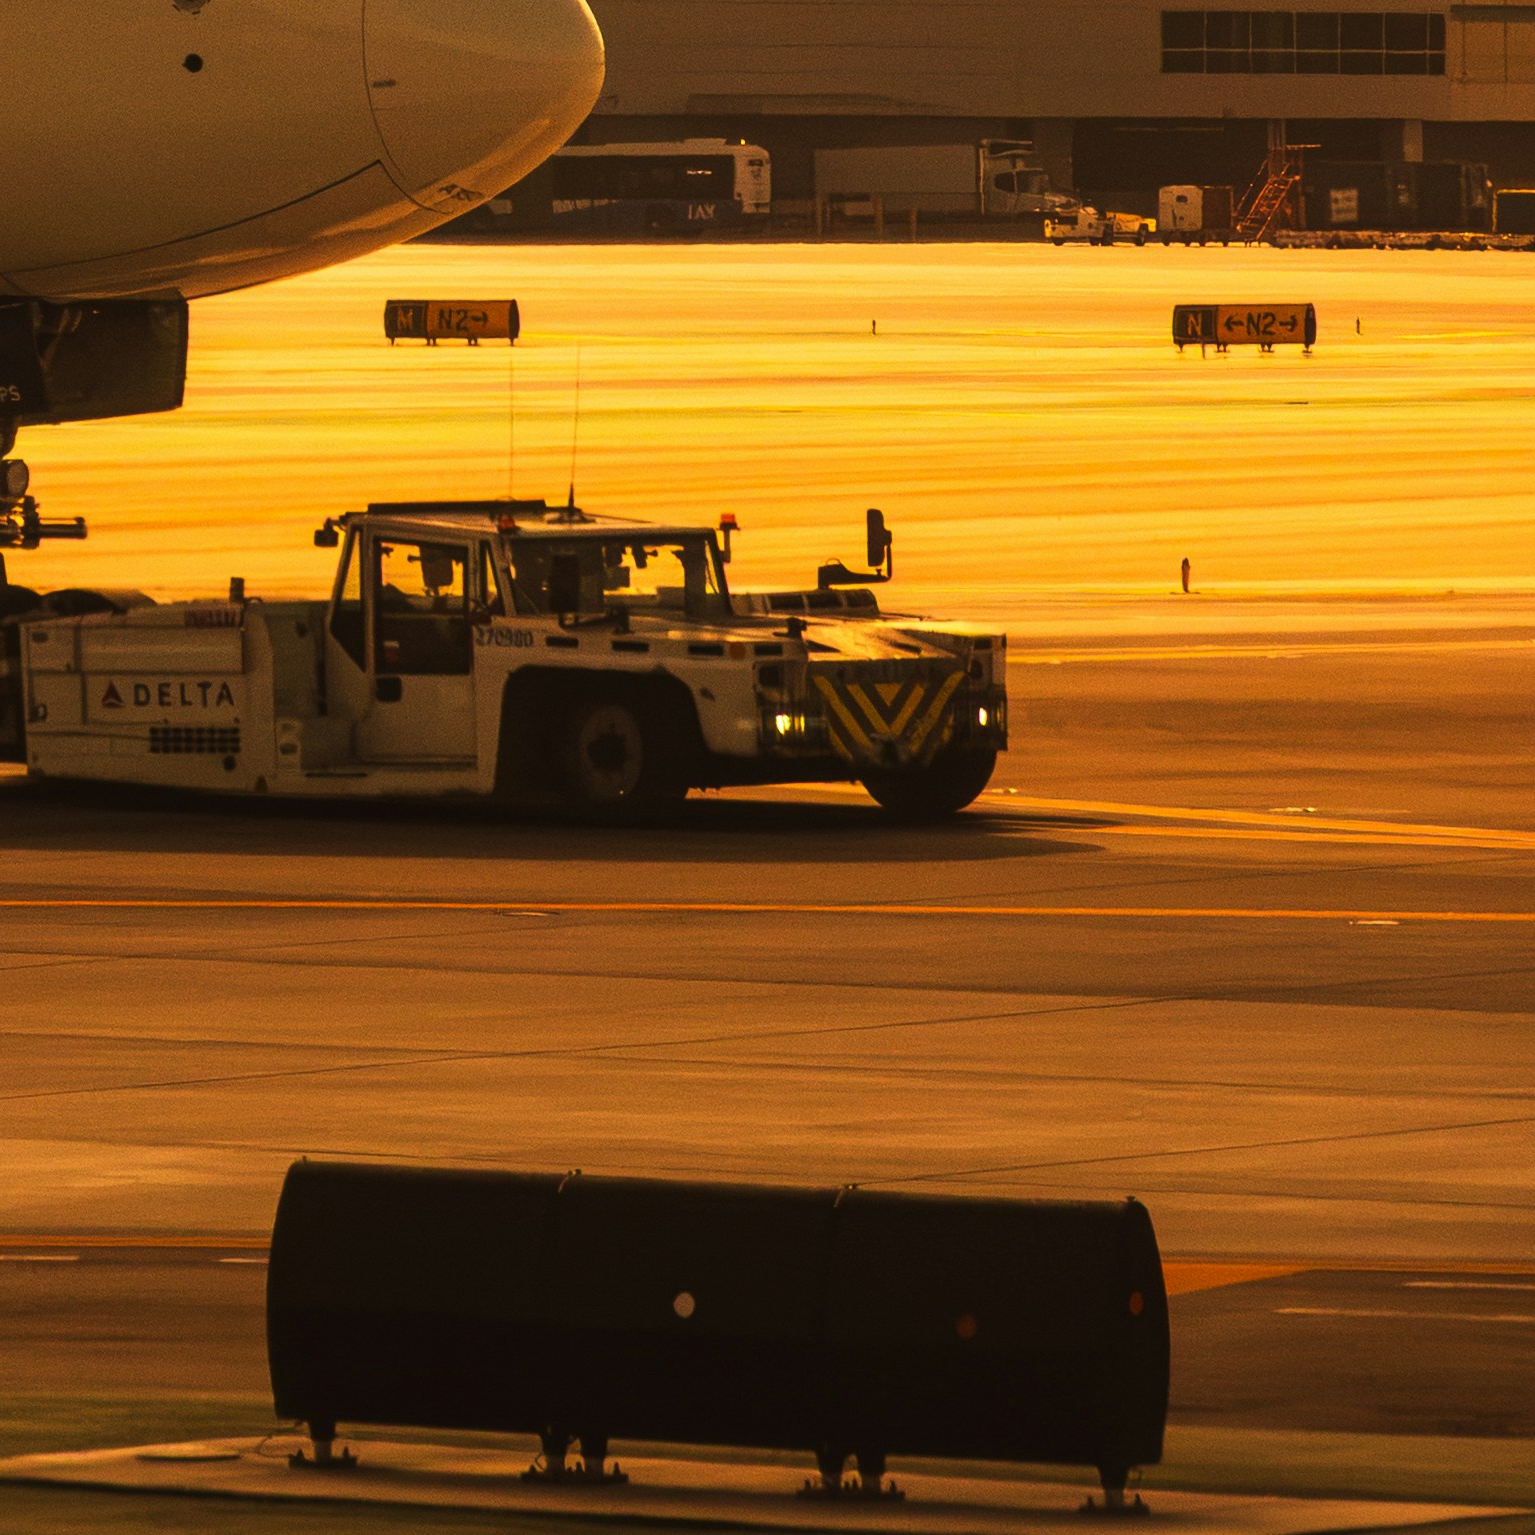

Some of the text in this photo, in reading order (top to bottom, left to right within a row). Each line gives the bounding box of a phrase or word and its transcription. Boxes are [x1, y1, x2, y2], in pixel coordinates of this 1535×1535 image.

[438, 307, 470, 332] N2
[1186, 311, 1277, 337] N N2
[132, 680, 235, 708] DELTA
